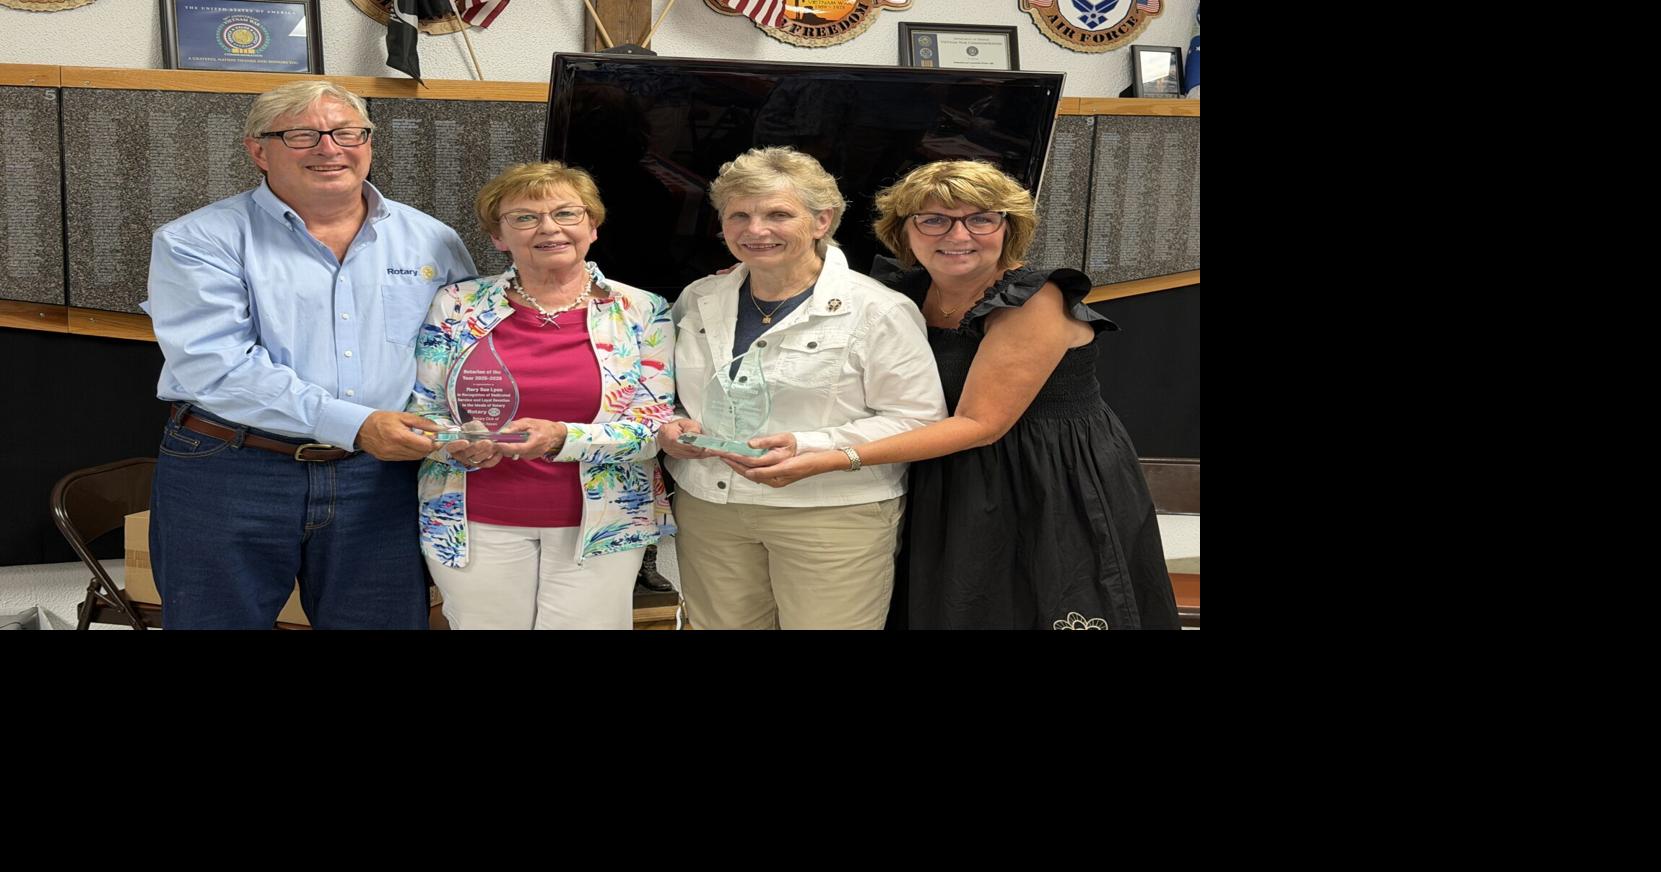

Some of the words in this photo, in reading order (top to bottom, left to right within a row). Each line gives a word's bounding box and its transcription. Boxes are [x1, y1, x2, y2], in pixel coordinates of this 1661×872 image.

[789, 3, 869, 37] FREEDOM
[1048, 14, 1076, 39] AIR
[1079, 17, 1138, 43] FORCE
[44, 90, 56, 100] 5
[386, 268, 418, 277] Rotary
